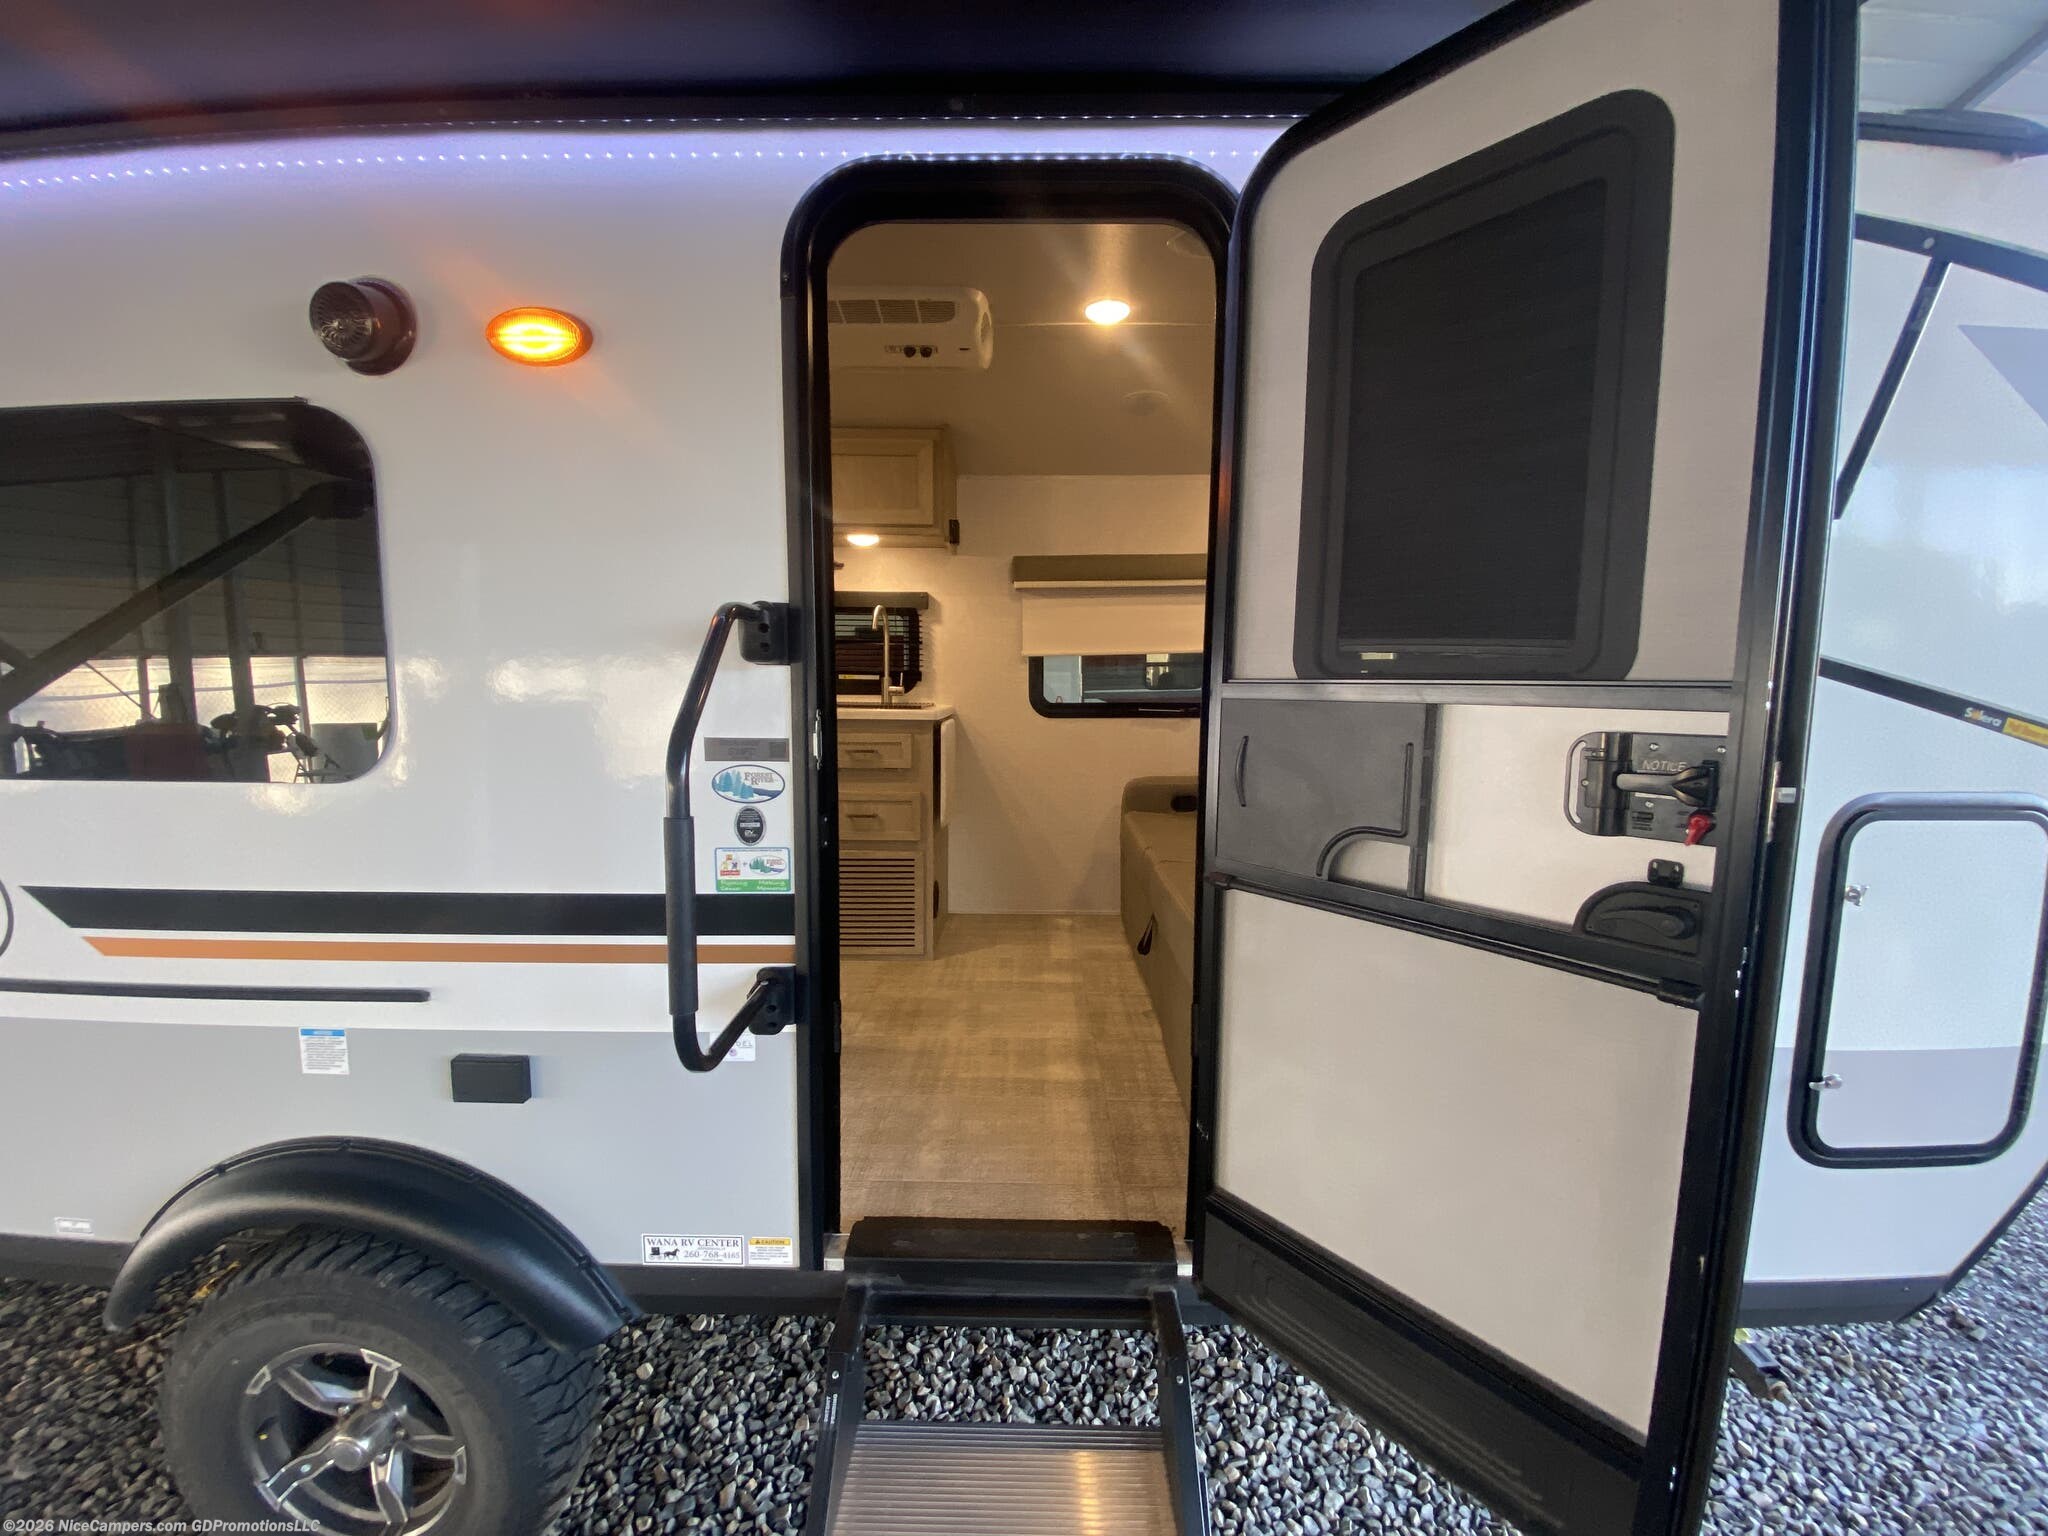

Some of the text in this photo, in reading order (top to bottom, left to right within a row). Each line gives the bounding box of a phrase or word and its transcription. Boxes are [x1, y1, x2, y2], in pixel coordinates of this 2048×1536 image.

[1642, 760, 1687, 772] NOTICE
[744, 771, 774, 781] FOREST
[750, 777, 774, 785] RIVER
[647, 1238, 678, 1246] WANA
[697, 1239, 739, 1247] CENTER
